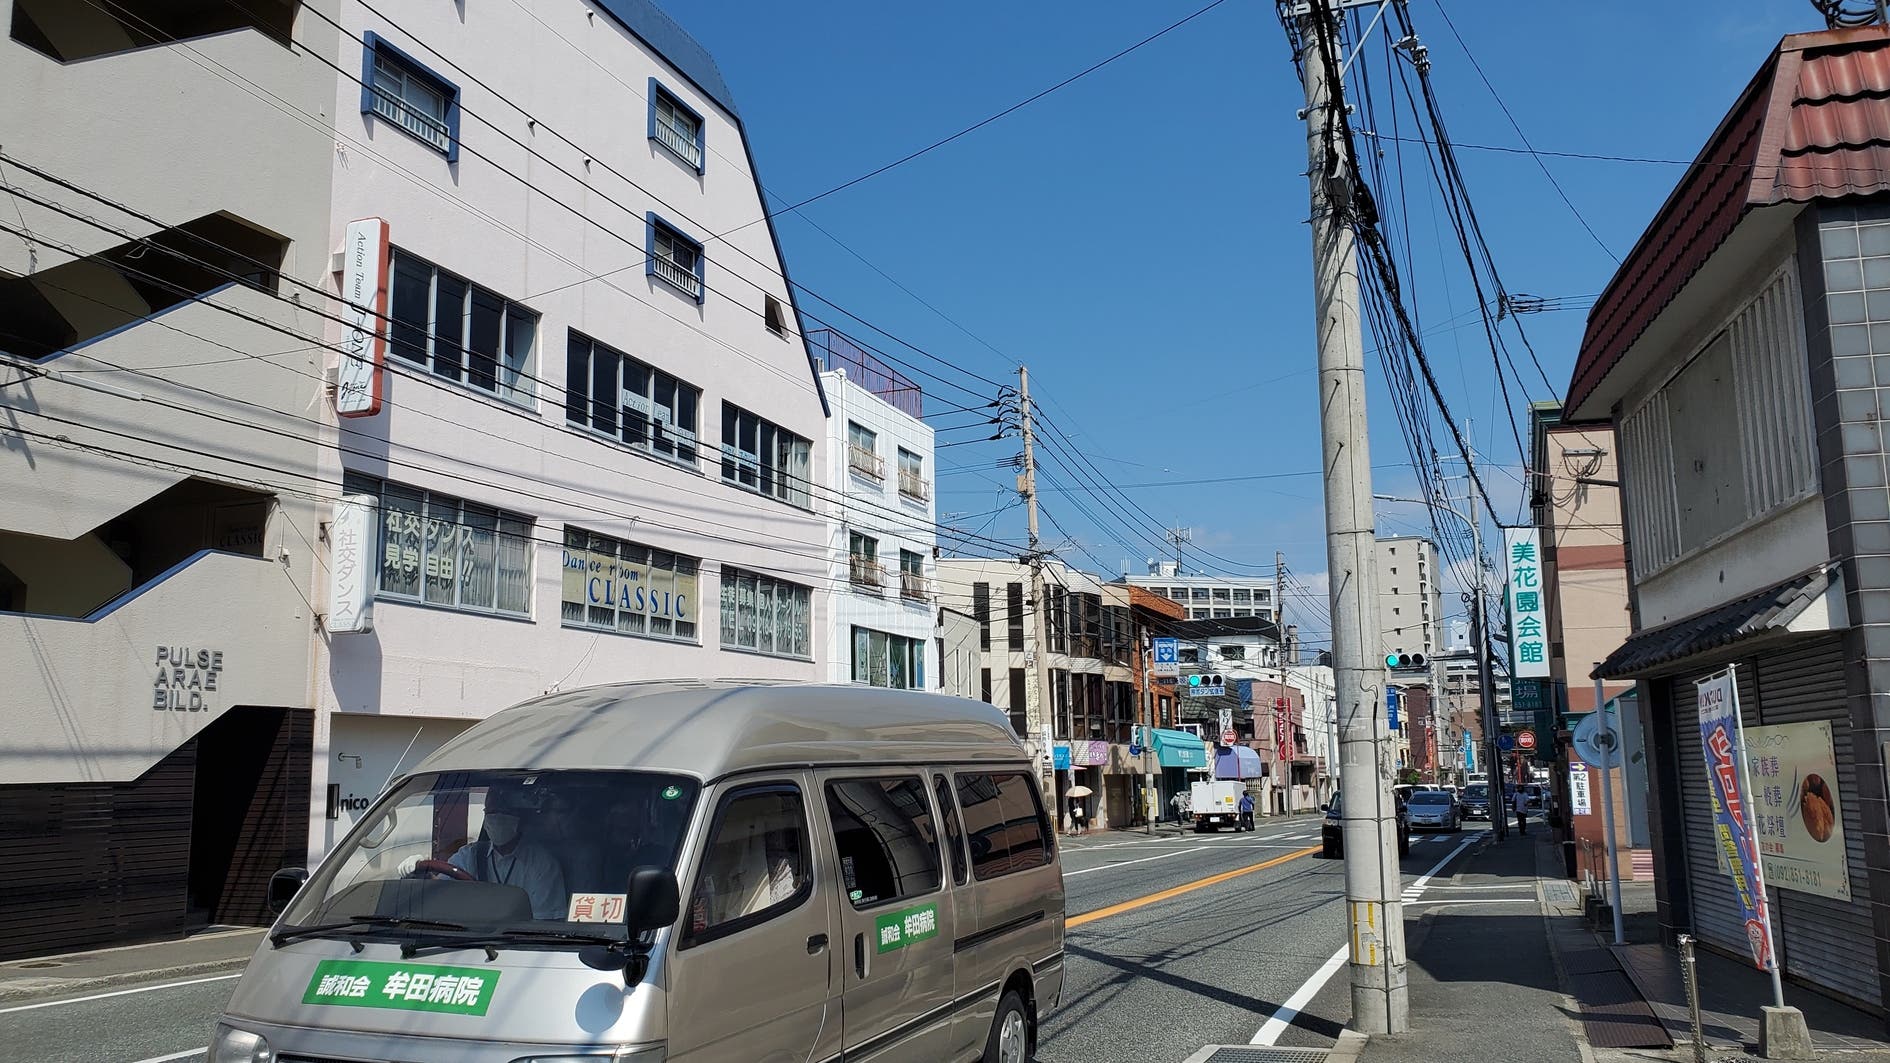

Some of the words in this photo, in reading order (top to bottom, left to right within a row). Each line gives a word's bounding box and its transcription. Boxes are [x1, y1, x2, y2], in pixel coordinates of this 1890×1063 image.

[356, 231, 366, 267] Action
[354, 272, 364, 299] Team
[386, 506, 475, 549] 社交ダンス
[336, 529, 357, 616] 社交ダンス
[563, 550, 601, 574] Dance
[589, 577, 686, 618] CLASSIC
[1512, 542, 1543, 663] 美花園会館
[155, 645, 223, 672] PULSE
[154, 667, 217, 691] ARAE
[153, 689, 208, 712] BILD.
[1752, 757, 1780, 777] 家族葬
[1755, 786, 1782, 807] 一般葬
[573, 896, 623, 920] 貸切
[881, 923, 901, 945] 誠和会
[904, 908, 935, 938] 牟田病院
[316, 974, 372, 998] 誠和会
[382, 971, 484, 1006] 牟田病院
